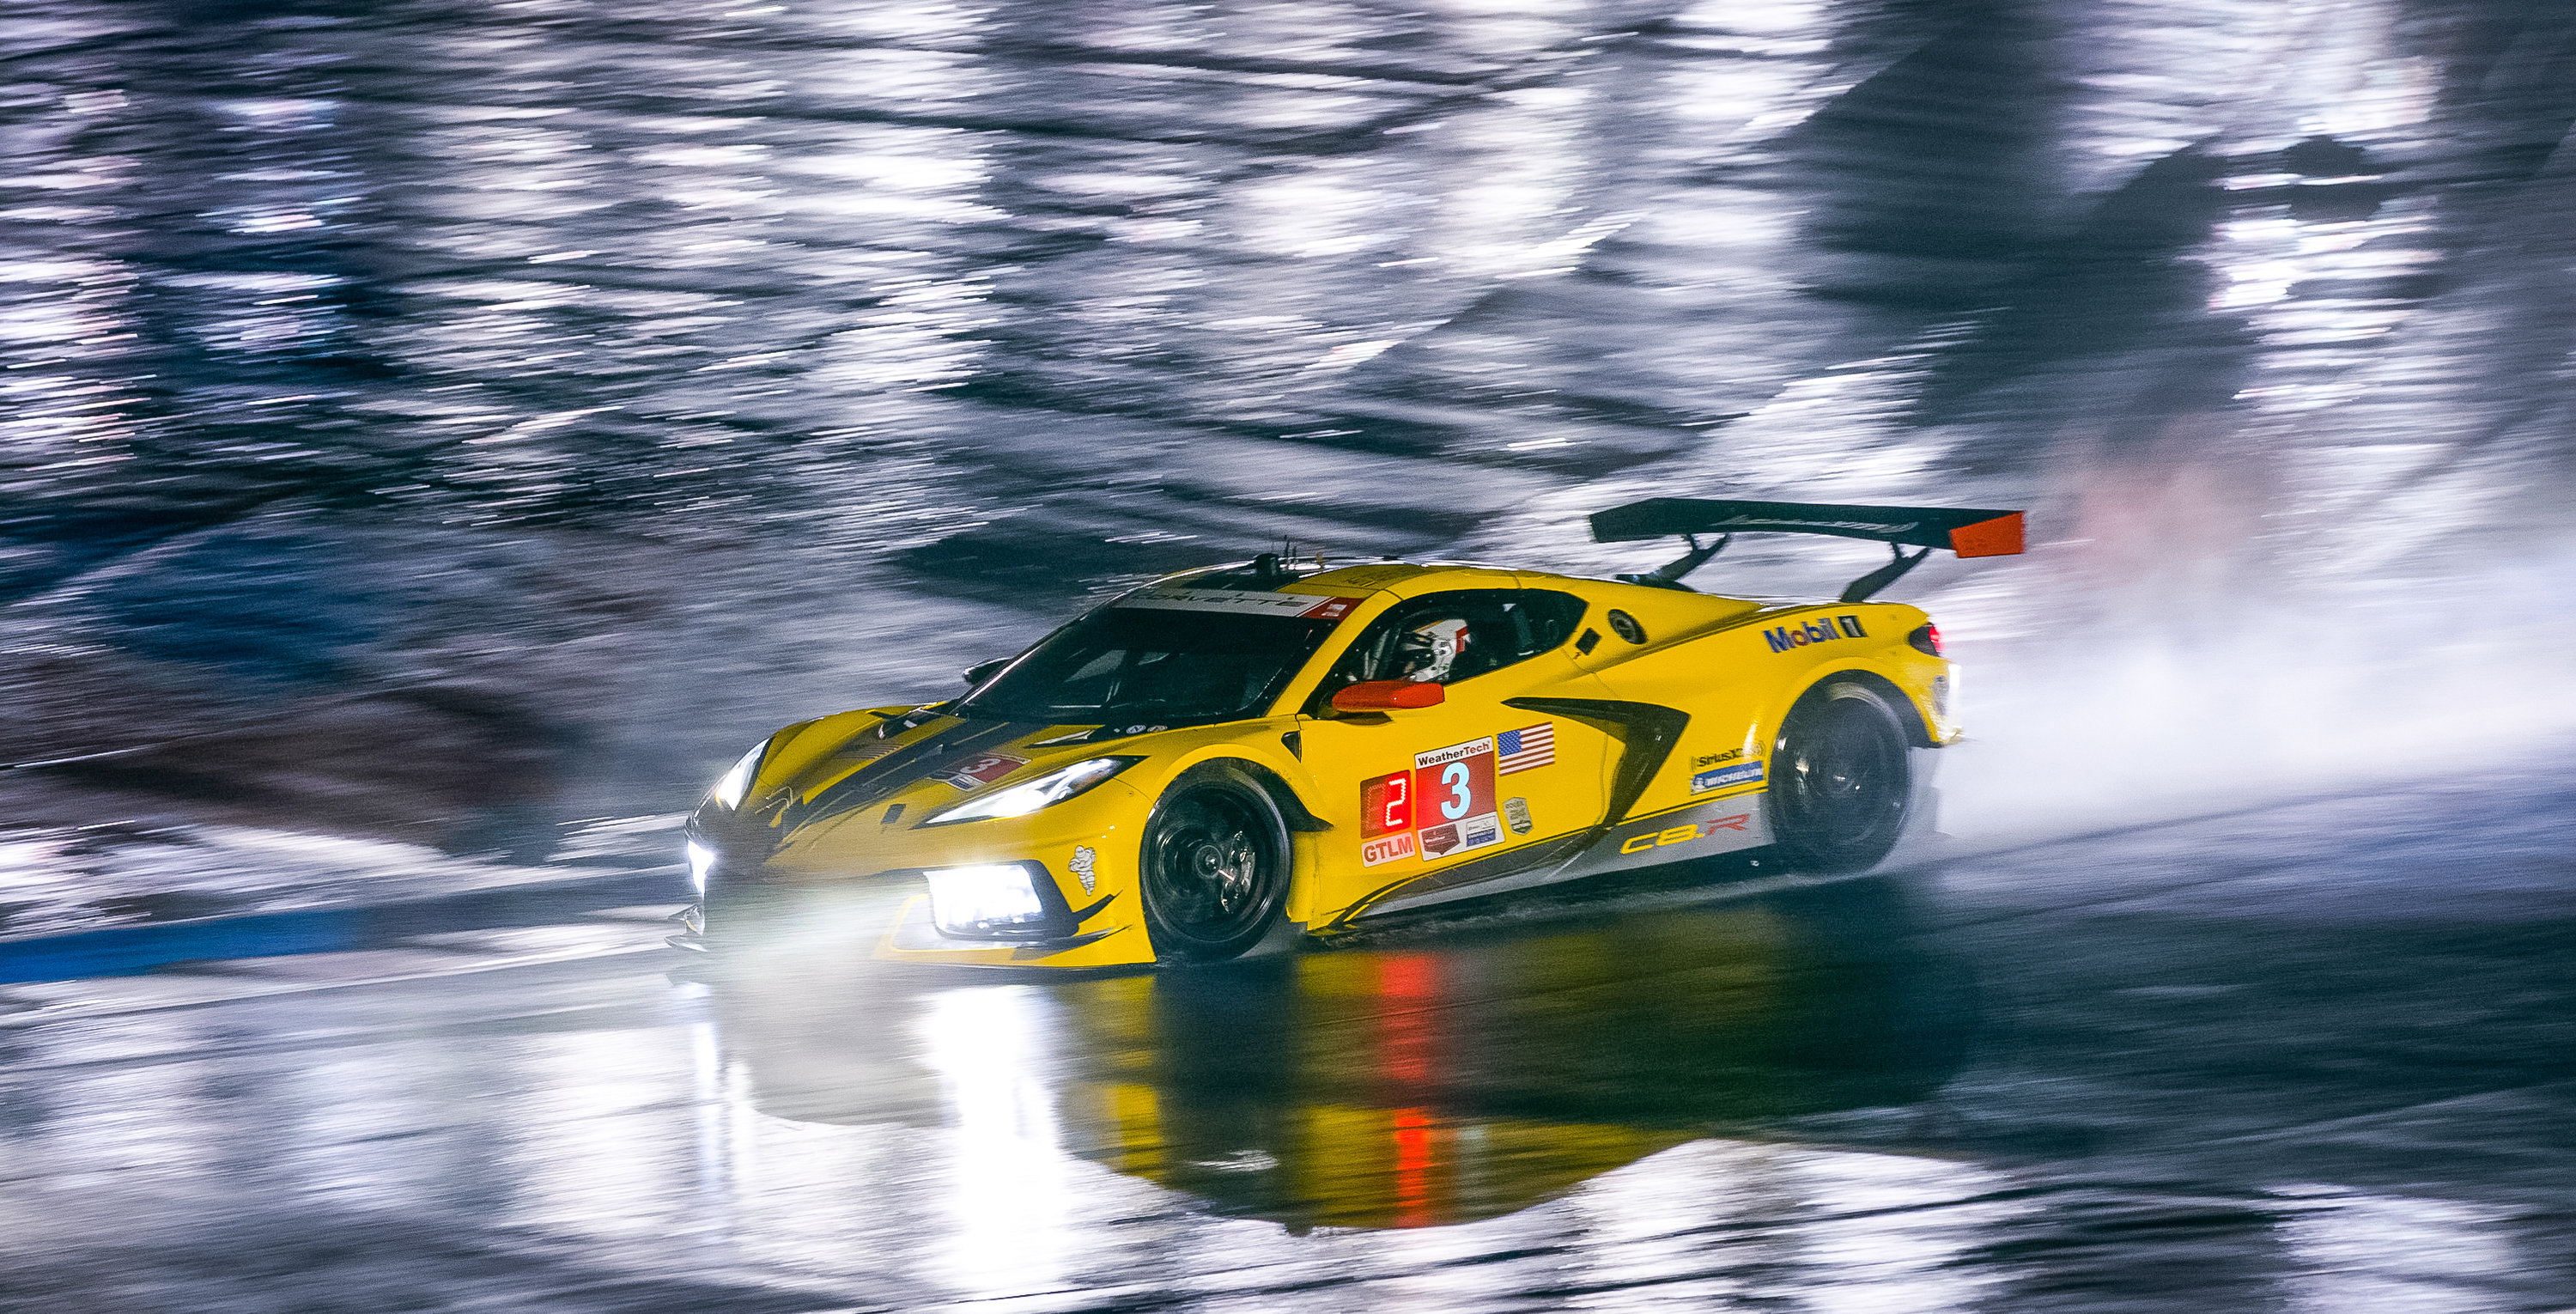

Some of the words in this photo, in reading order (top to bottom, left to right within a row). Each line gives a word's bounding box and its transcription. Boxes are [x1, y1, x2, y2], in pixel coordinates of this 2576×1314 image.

[1763, 617, 1841, 653] Mobil
[1840, 616, 1863, 637] 1
[960, 758, 1001, 774] 3
[1418, 741, 1491, 766] WeatherTech
[1697, 746, 1753, 767] SiriusX
[1385, 777, 1406, 827] 2
[1440, 762, 1472, 820] 3
[1364, 836, 1413, 862] GTLM
